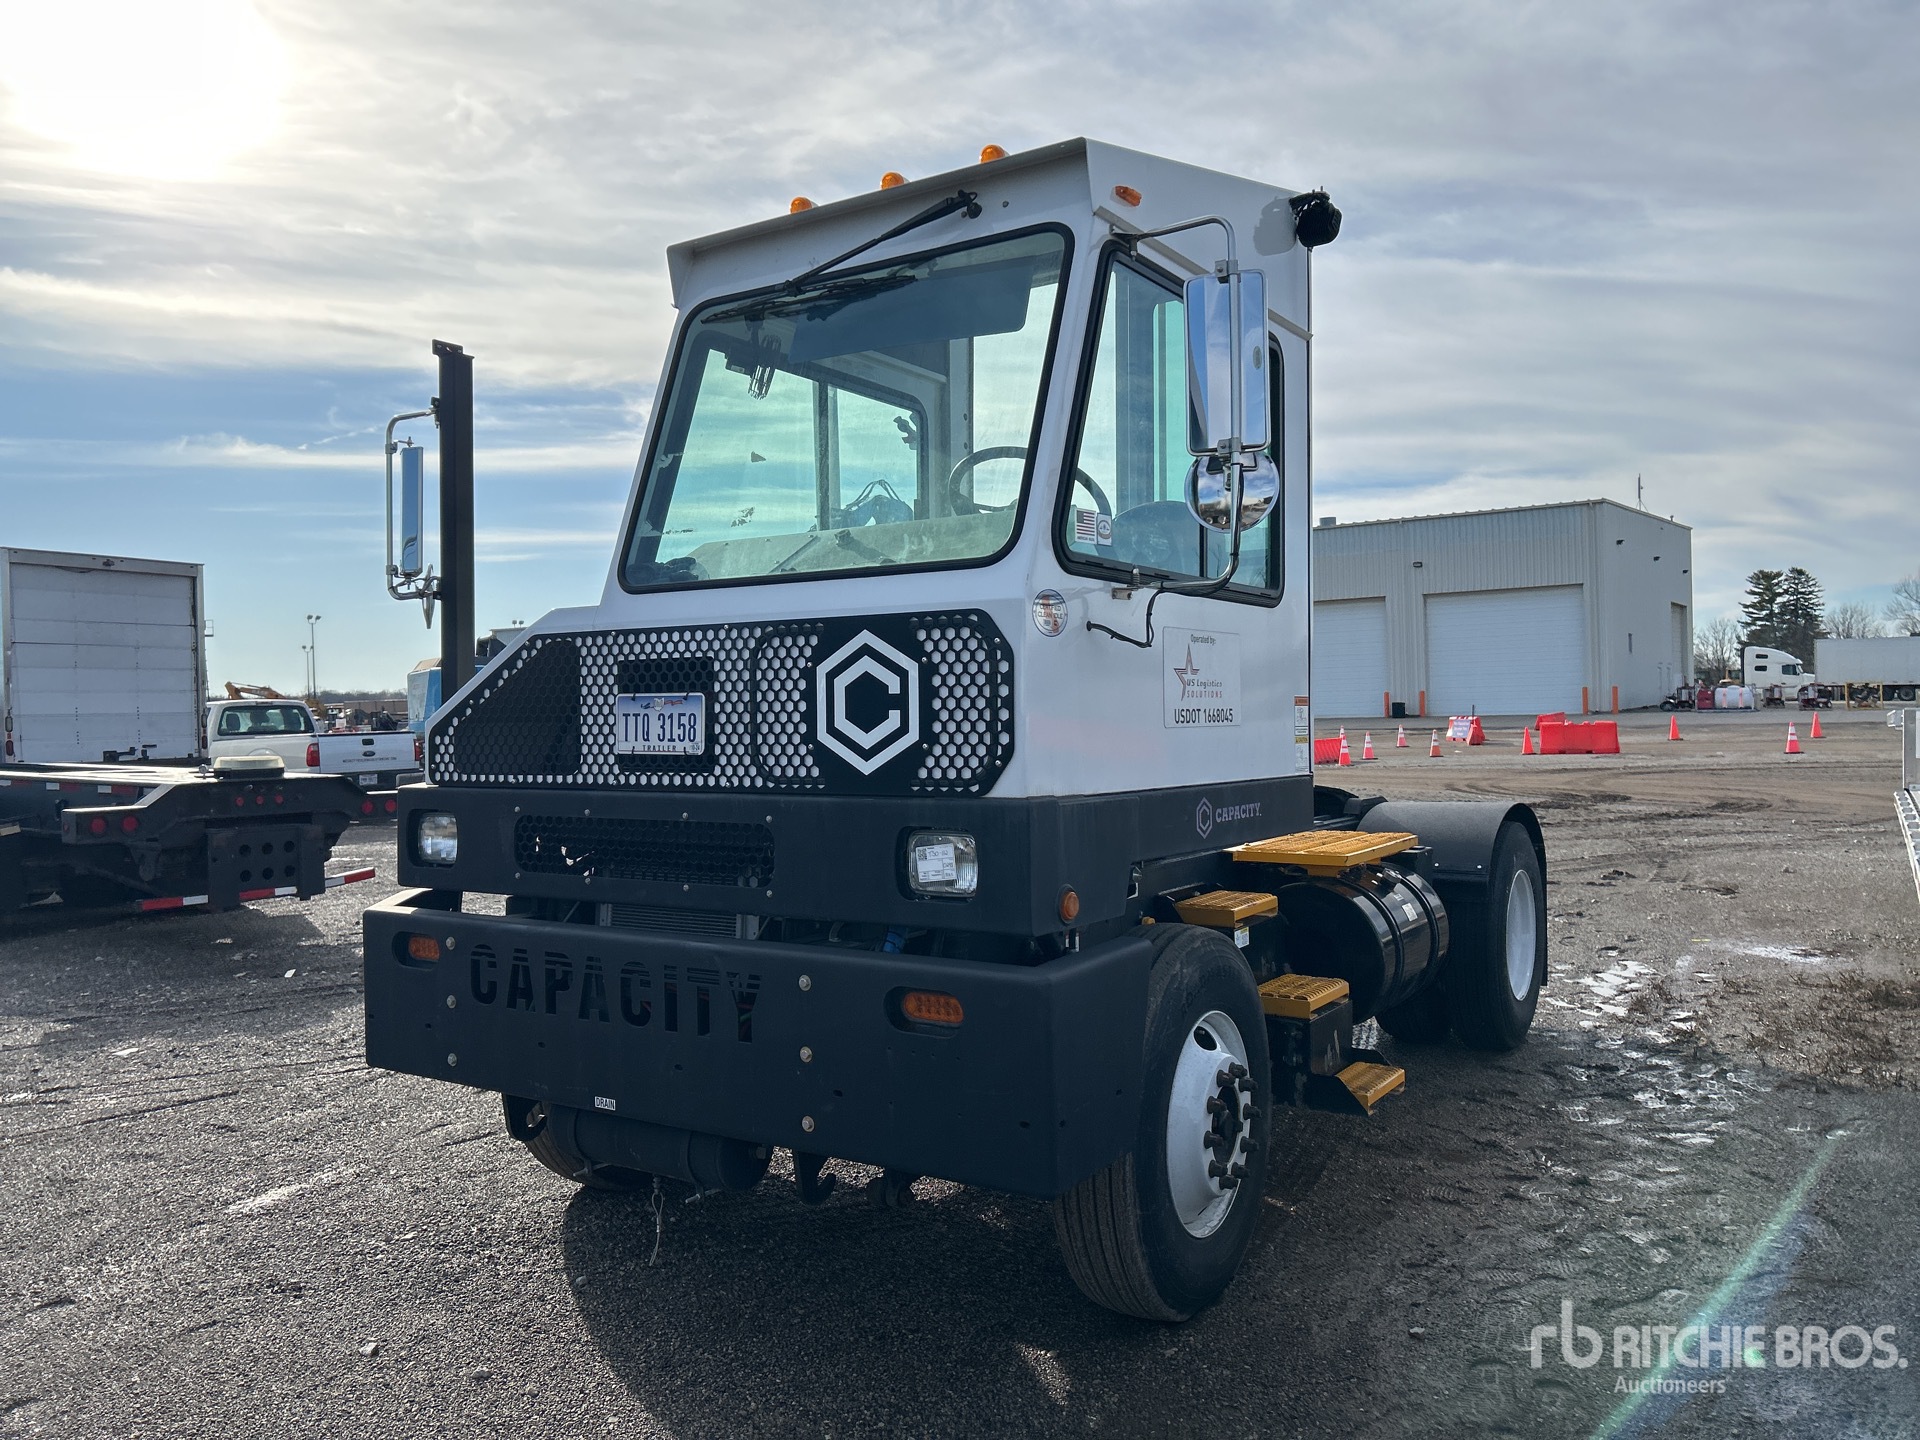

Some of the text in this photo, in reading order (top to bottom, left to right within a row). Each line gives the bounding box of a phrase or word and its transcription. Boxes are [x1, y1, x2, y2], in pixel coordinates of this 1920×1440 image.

[1037, 610, 1053, 619] CLEAN
[1190, 633, 1217, 646] Operated by:
[1186, 678, 1196, 687] US
[1186, 690, 1223, 699] SOLUTIONS
[1174, 708, 1234, 724] USDOT 1668045
[622, 712, 697, 743] TTQ 3158
[642, 744, 677, 752] TRAILER
[470, 944, 762, 1044] CAPACITY
[595, 1097, 615, 1110] DRAIN
